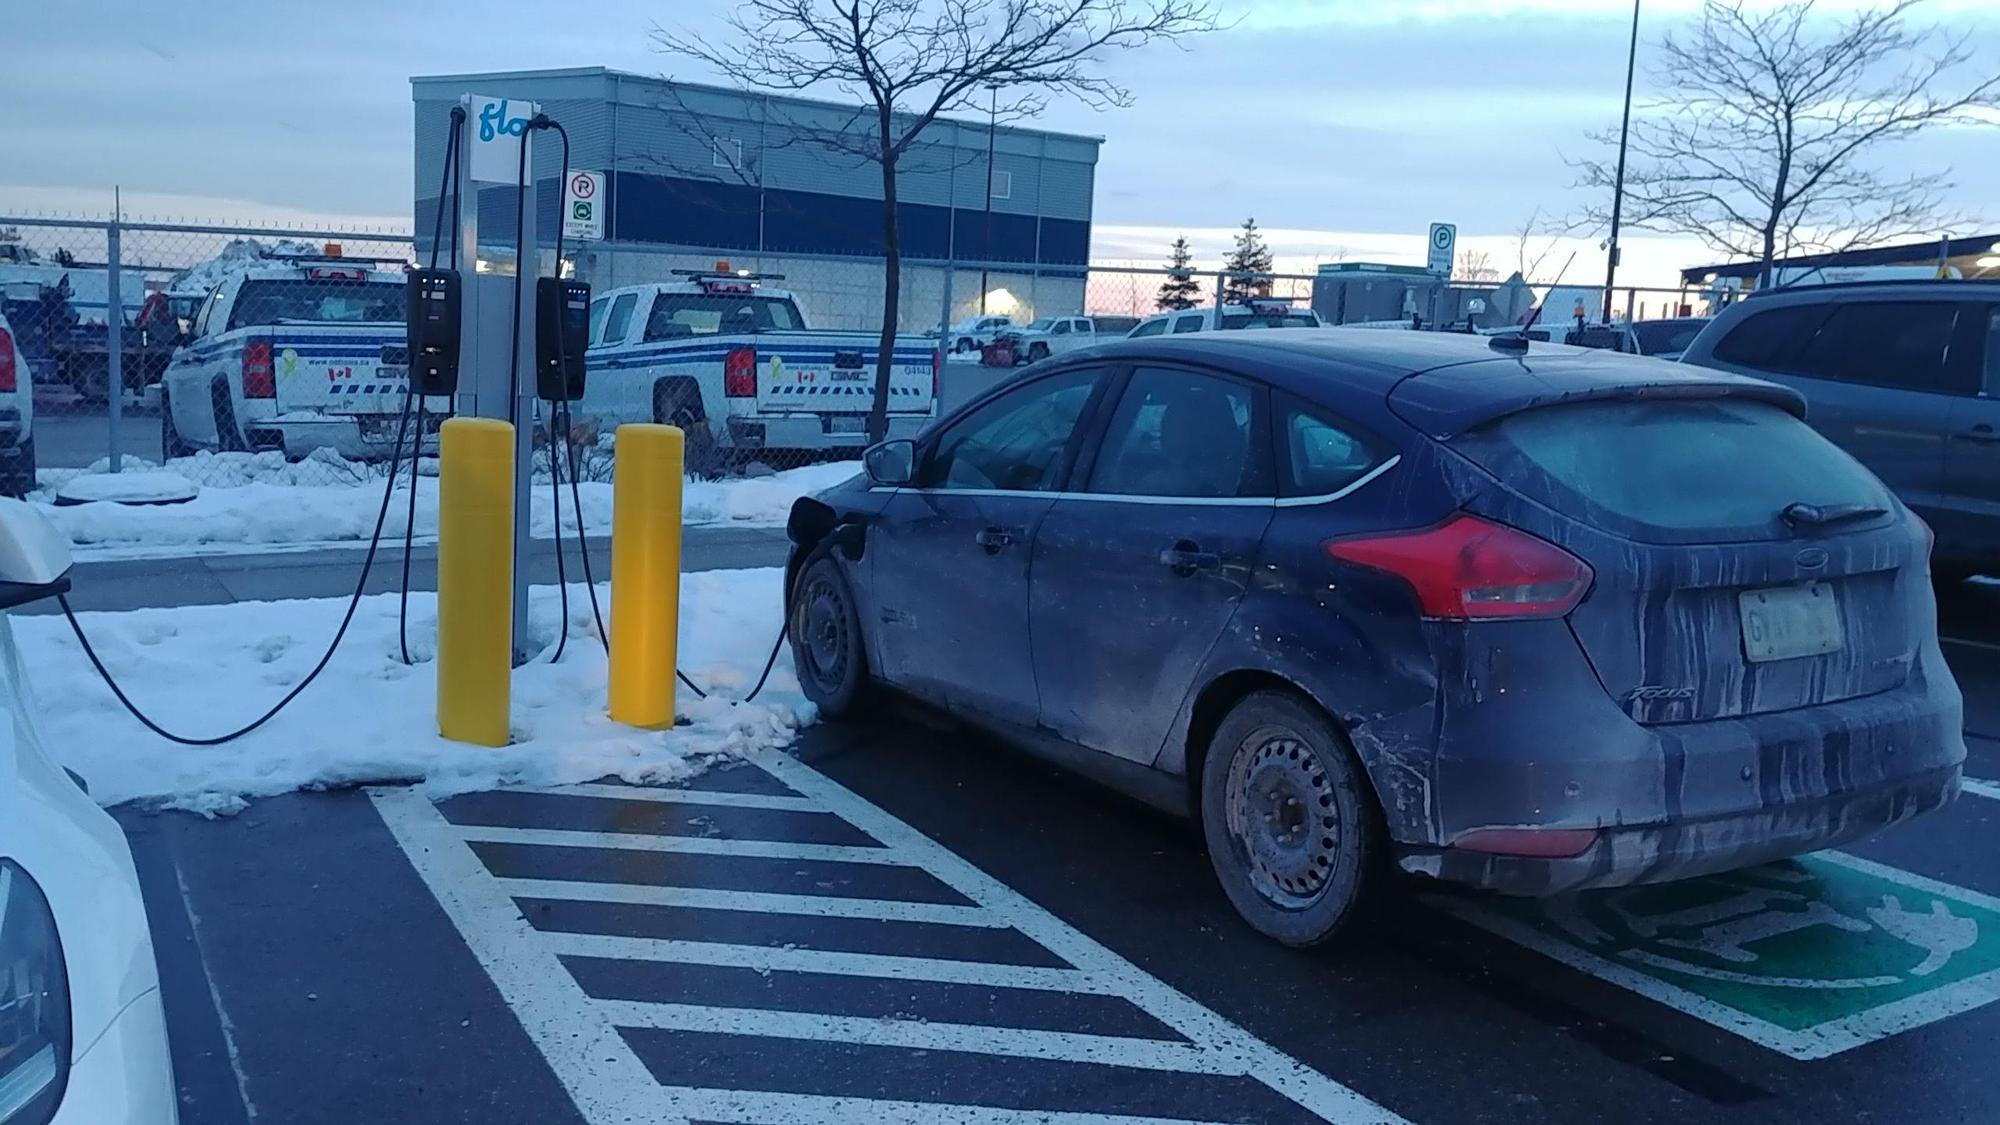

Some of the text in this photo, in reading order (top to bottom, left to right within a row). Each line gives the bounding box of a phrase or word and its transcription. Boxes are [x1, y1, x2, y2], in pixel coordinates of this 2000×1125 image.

[479, 100, 528, 142] flo
[1439, 232, 1448, 244] P
[830, 371, 868, 381] GMC
